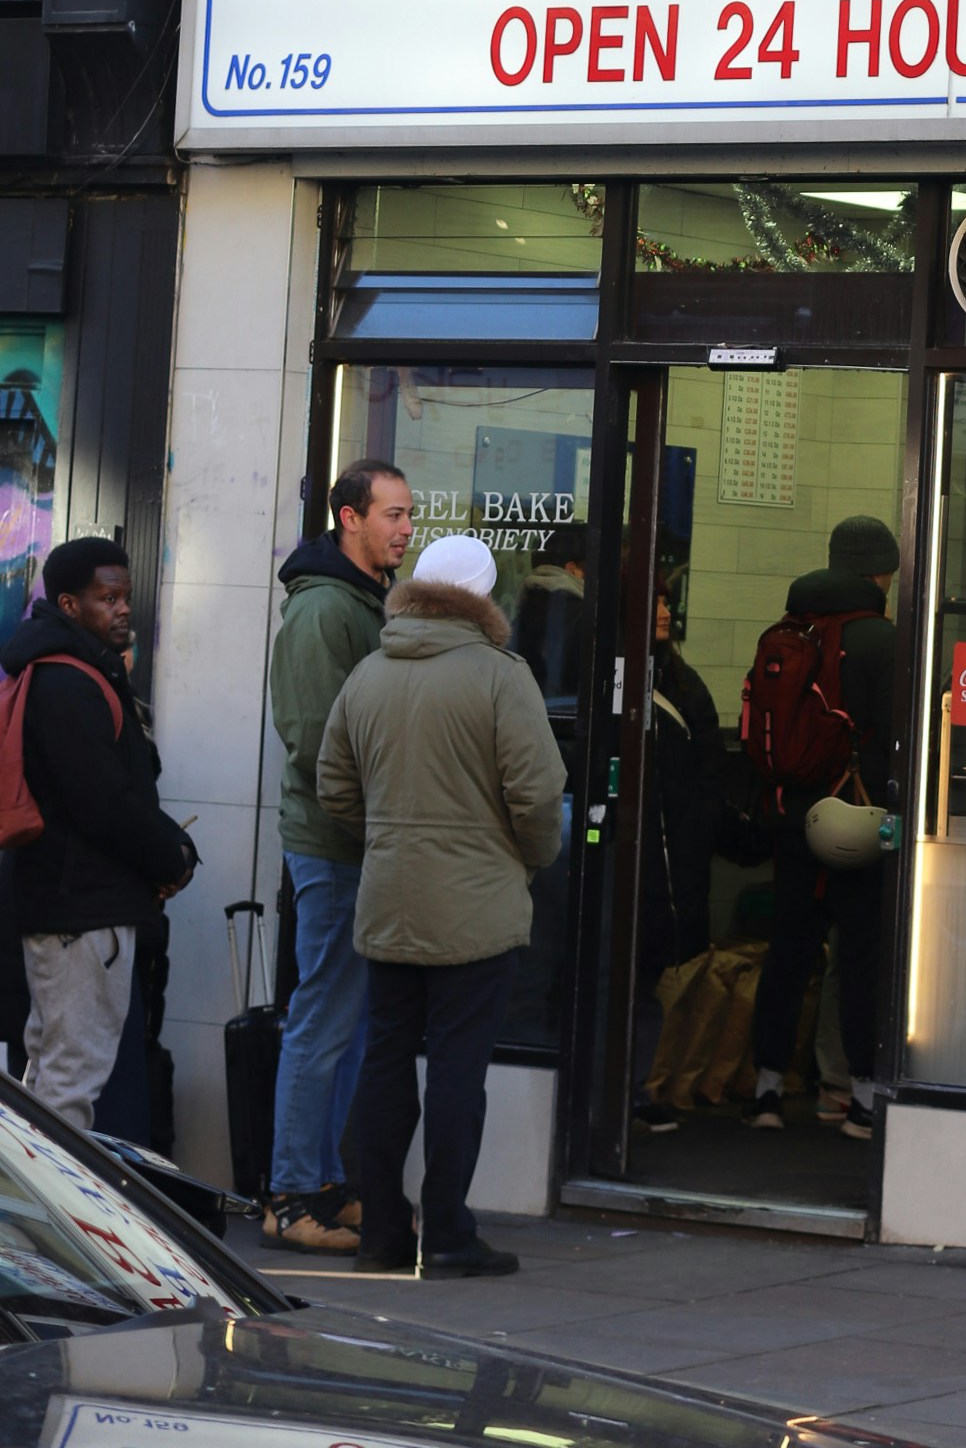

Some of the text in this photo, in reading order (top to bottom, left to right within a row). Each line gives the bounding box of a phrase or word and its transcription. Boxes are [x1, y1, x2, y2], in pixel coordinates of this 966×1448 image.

[491, 3, 679, 86] OPEN
[714, 0, 800, 80] 24
[411, 489, 575, 524] GEL BAKE
